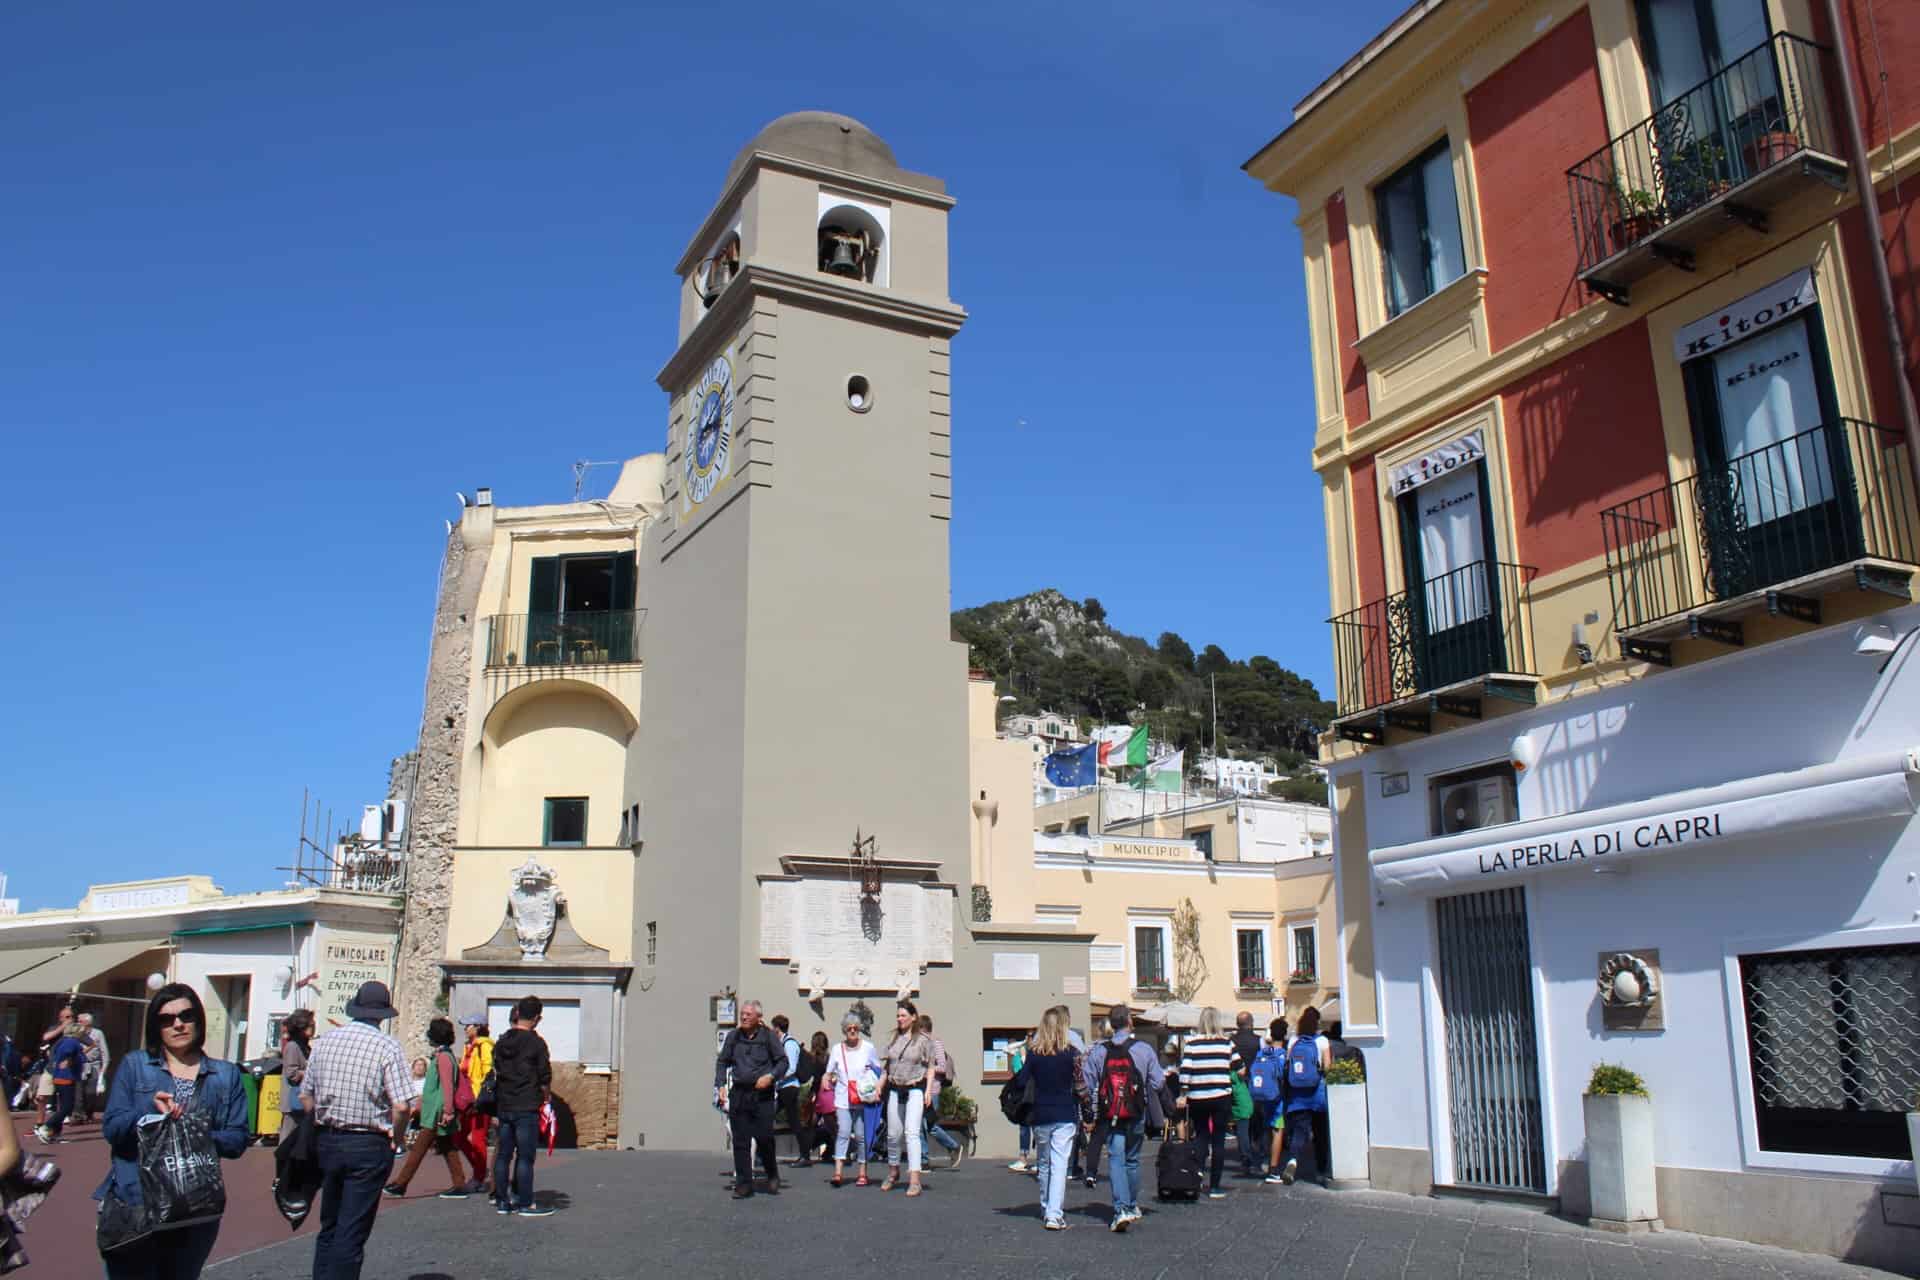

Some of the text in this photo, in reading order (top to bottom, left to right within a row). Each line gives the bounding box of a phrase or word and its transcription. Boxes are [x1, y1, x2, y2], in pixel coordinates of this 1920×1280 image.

[1685, 295, 1802, 357] Kiton
[1727, 351, 1801, 386] Kiton
[1399, 447, 1475, 491] Kiton
[1113, 843, 1180, 857] MUNICIPIO
[1479, 813, 1721, 873] LA PERLA DI CAPRI
[327, 946, 386, 961] FUNICOLARE
[334, 969, 376, 979] ENTRATA
[328, 981, 359, 990] ENTRA
[1274, 1000, 1282, 1015] T
